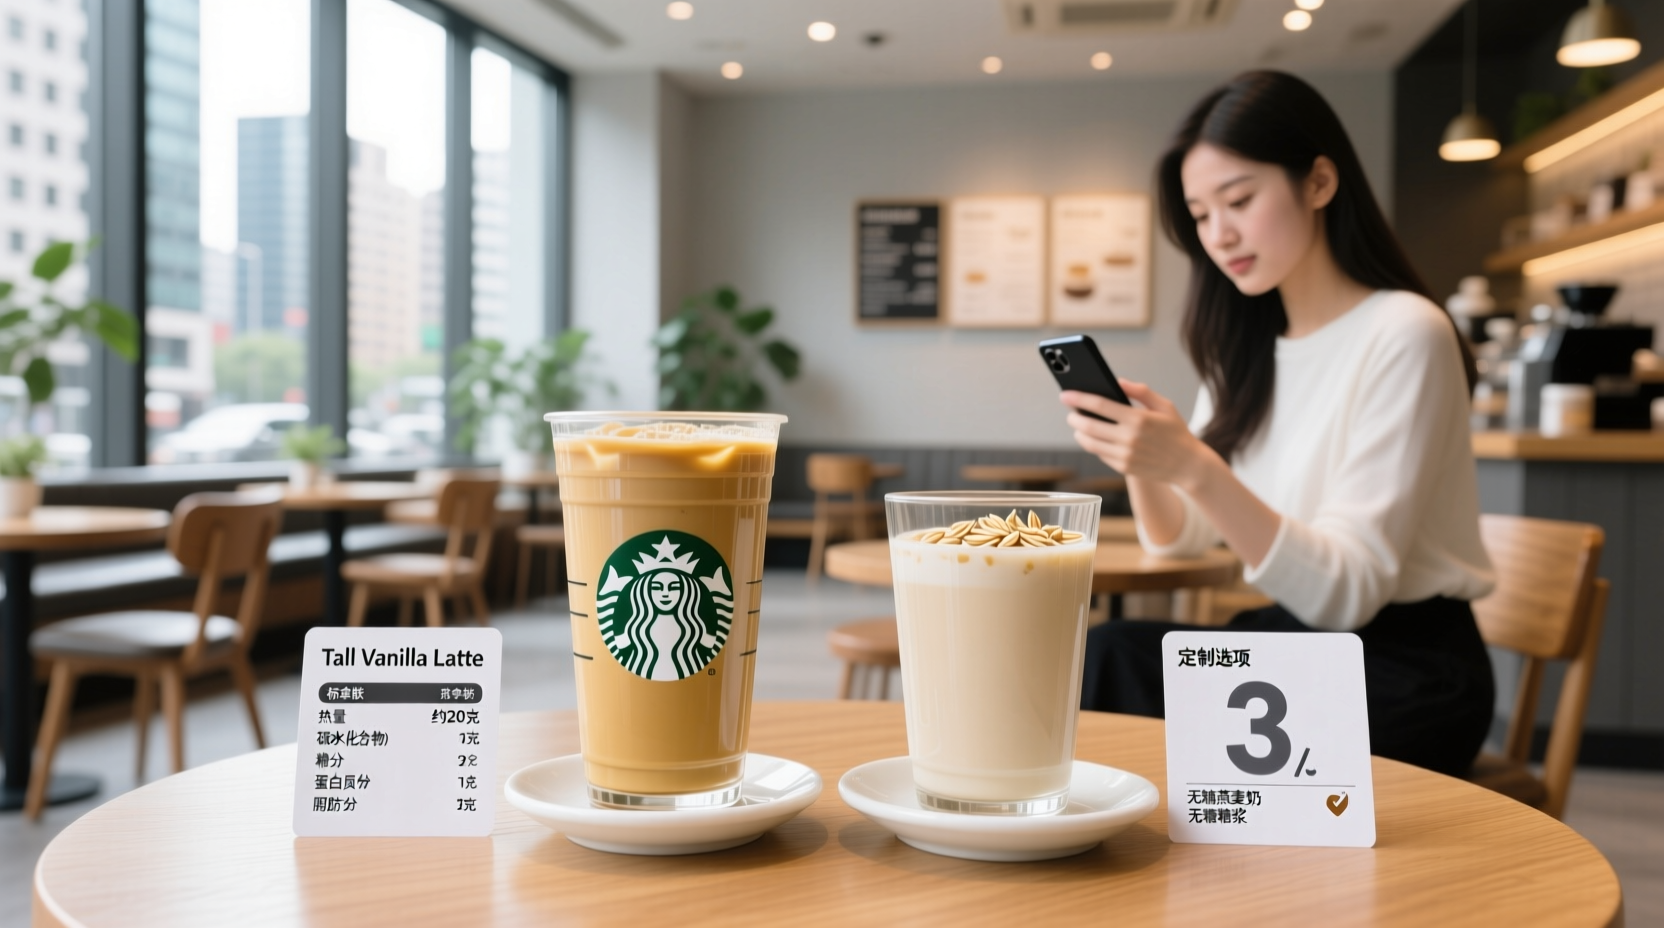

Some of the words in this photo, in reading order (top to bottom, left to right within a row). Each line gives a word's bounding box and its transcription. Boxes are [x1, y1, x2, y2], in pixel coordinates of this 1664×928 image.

[322, 647, 355, 667] Tall
[362, 647, 427, 667] Vanilla
[434, 649, 484, 667] Latte
[1178, 647, 1250, 667] 定制选项
